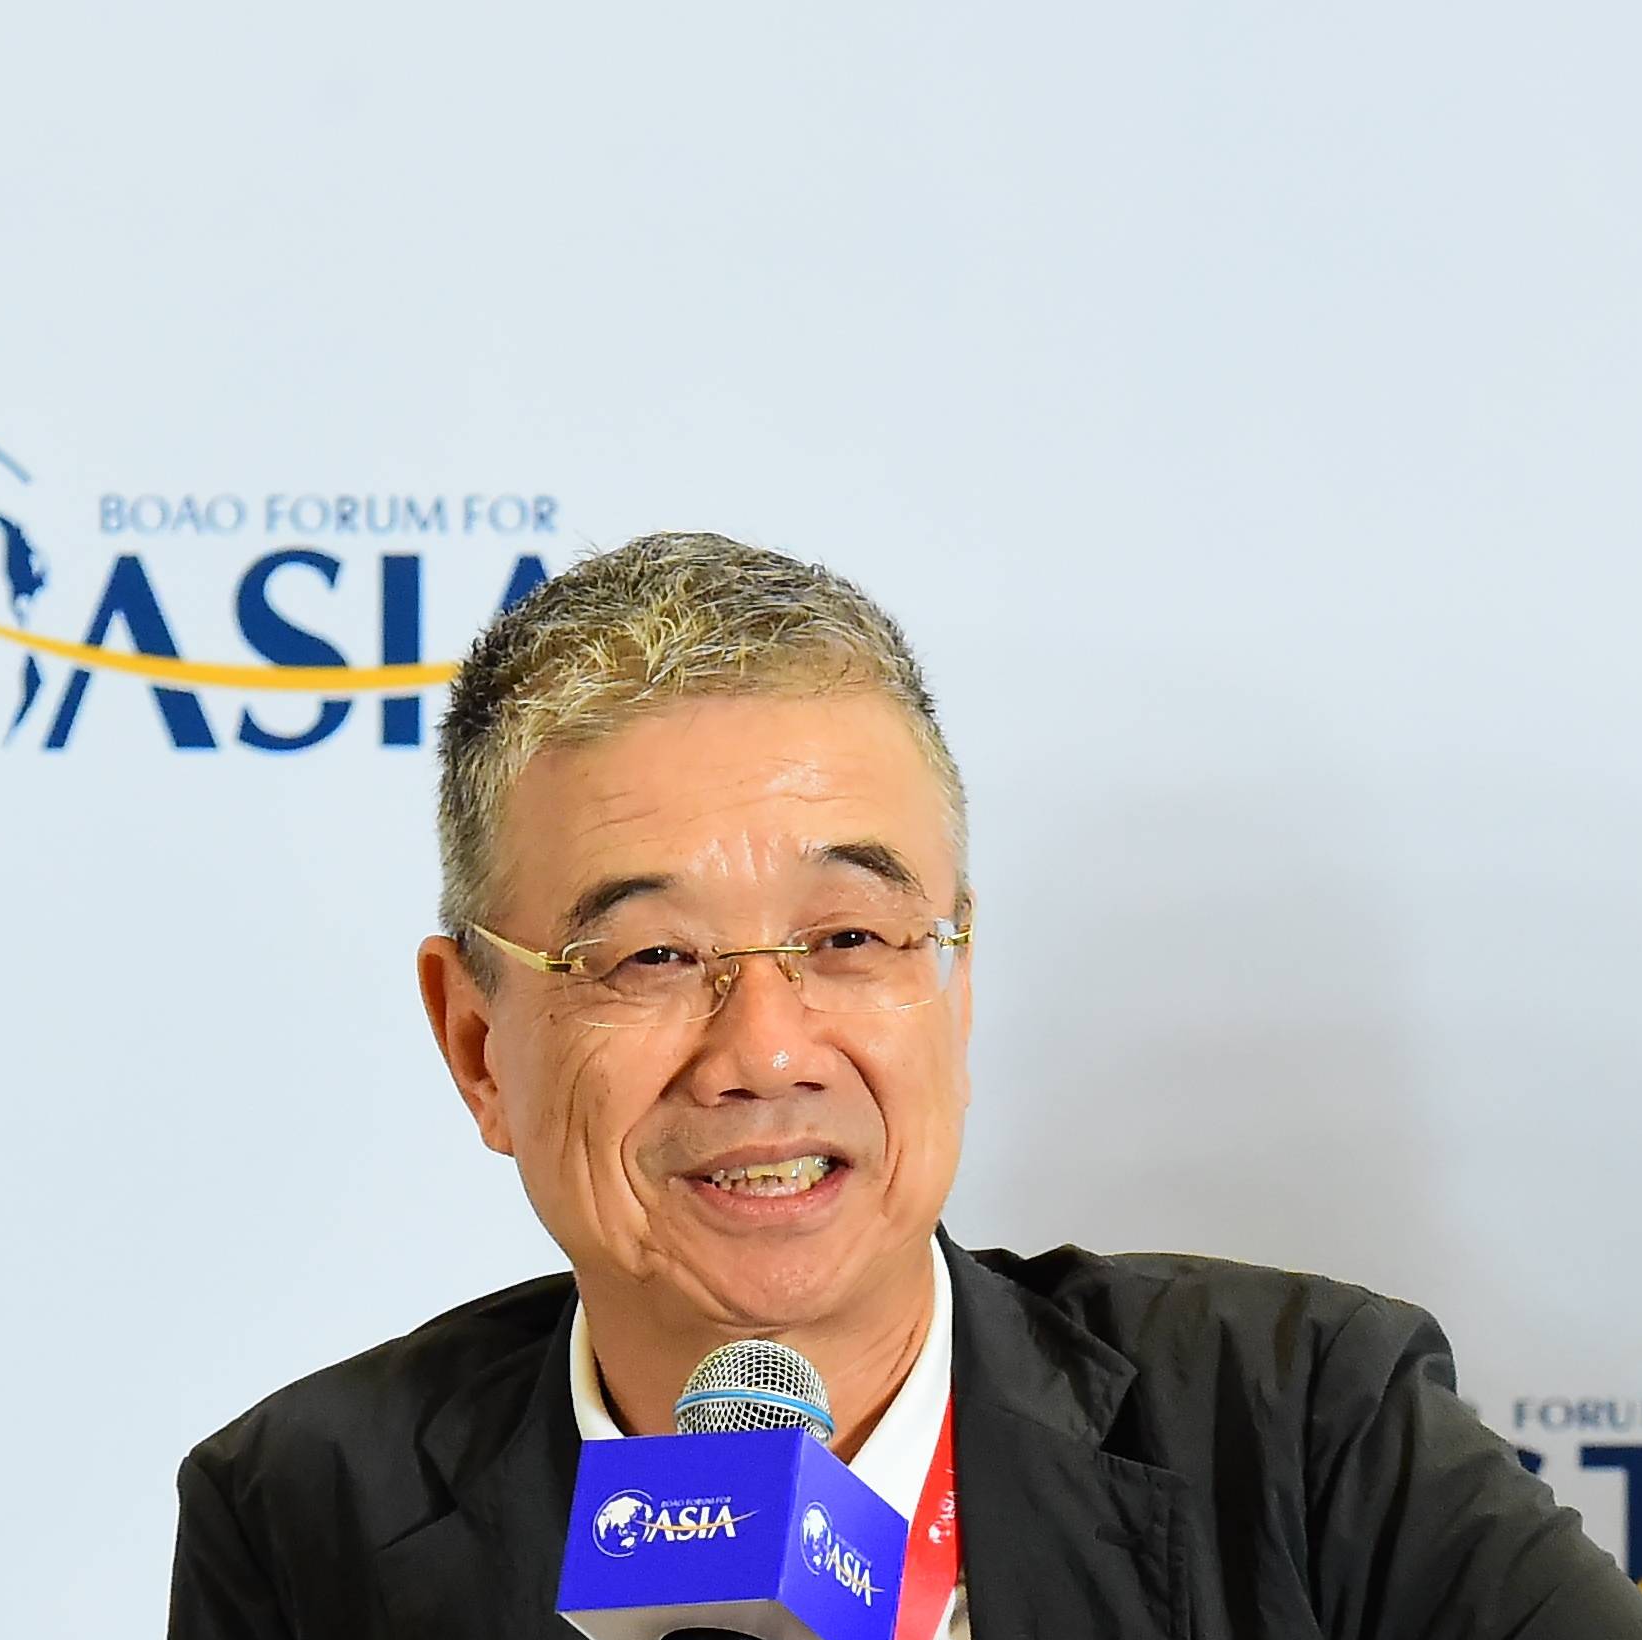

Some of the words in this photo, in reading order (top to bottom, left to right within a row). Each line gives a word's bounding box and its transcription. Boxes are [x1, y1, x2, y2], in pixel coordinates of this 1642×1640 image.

[99, 494, 246, 534] BOAO
[265, 494, 448, 534] FORUM
[463, 494, 557, 533] FOR
[46, 549, 549, 751] ASI
[647, 1505, 736, 1542] ASIA
[826, 1543, 872, 1607] ASIA
